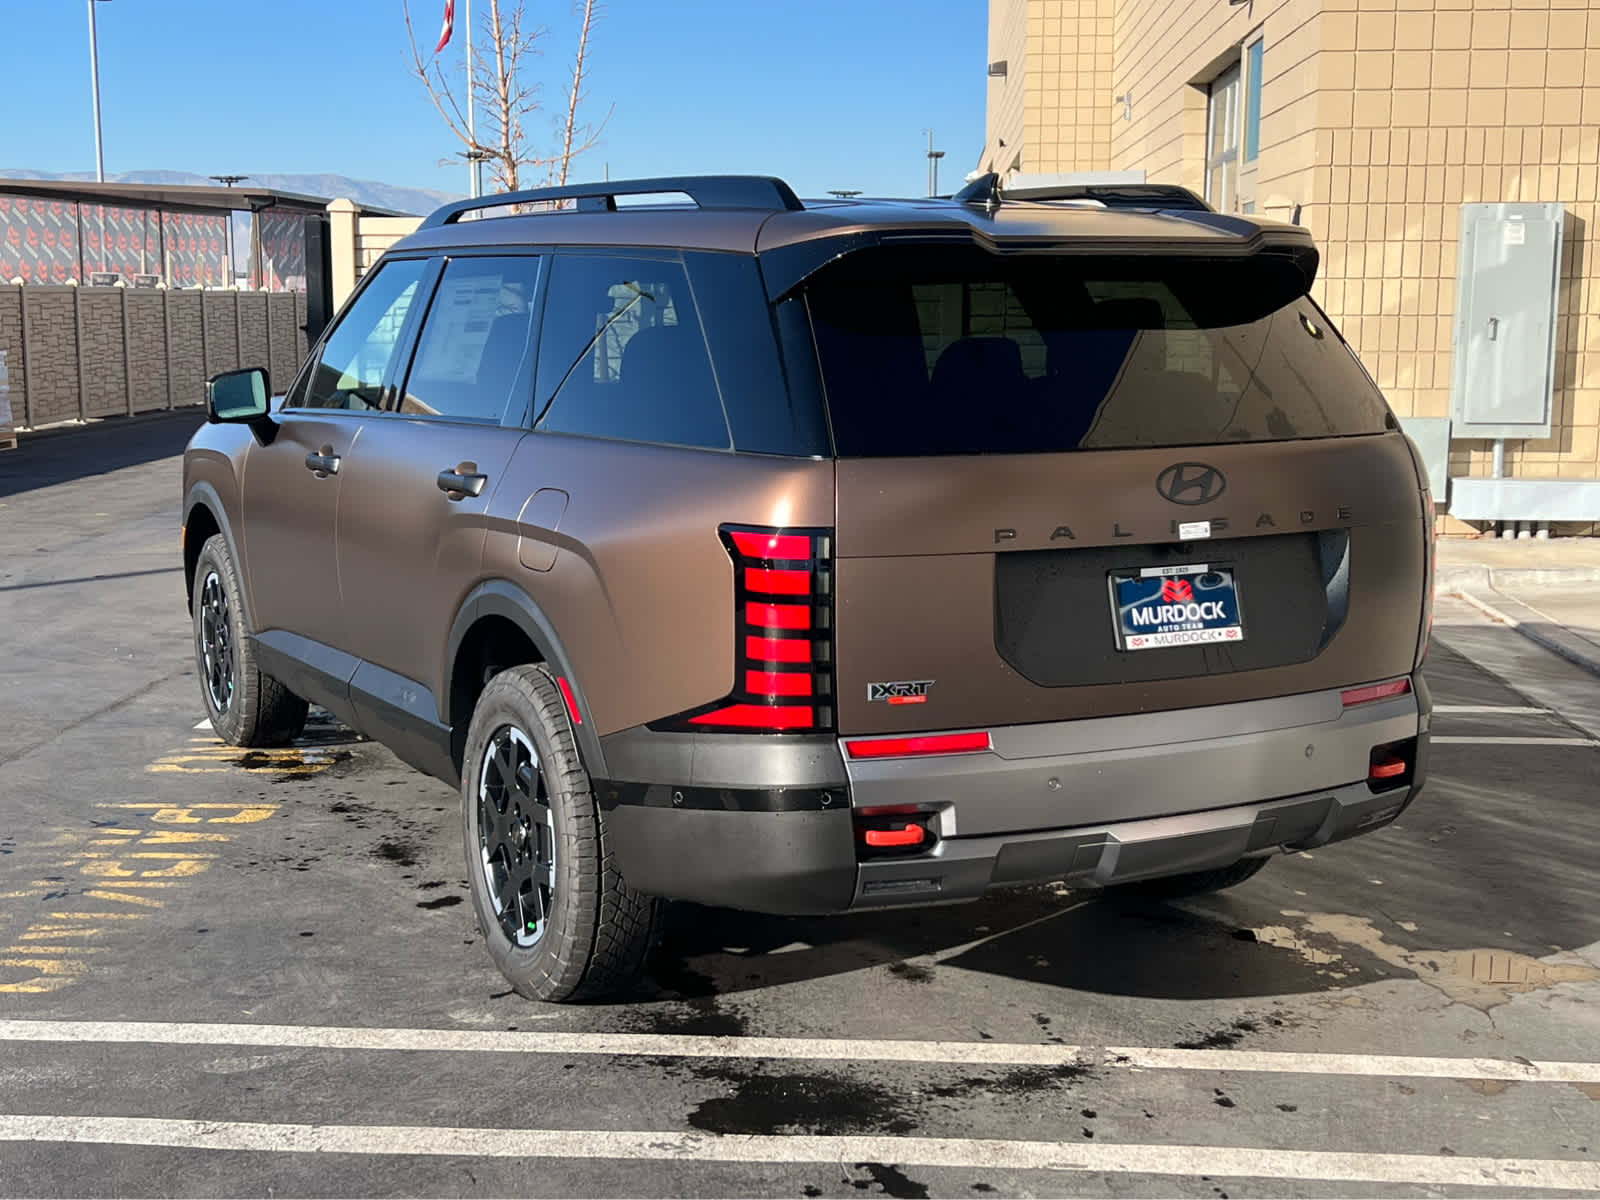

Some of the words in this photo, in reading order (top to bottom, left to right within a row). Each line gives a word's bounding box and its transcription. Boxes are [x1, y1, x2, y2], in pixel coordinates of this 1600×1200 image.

[994, 507, 1353, 543] PALISADE
[1131, 601, 1227, 626] MURDOCK
[1158, 625, 1180, 633] AUTO
[1182, 622, 1204, 630] TEAM
[1154, 631, 1217, 645] MURDOCK
